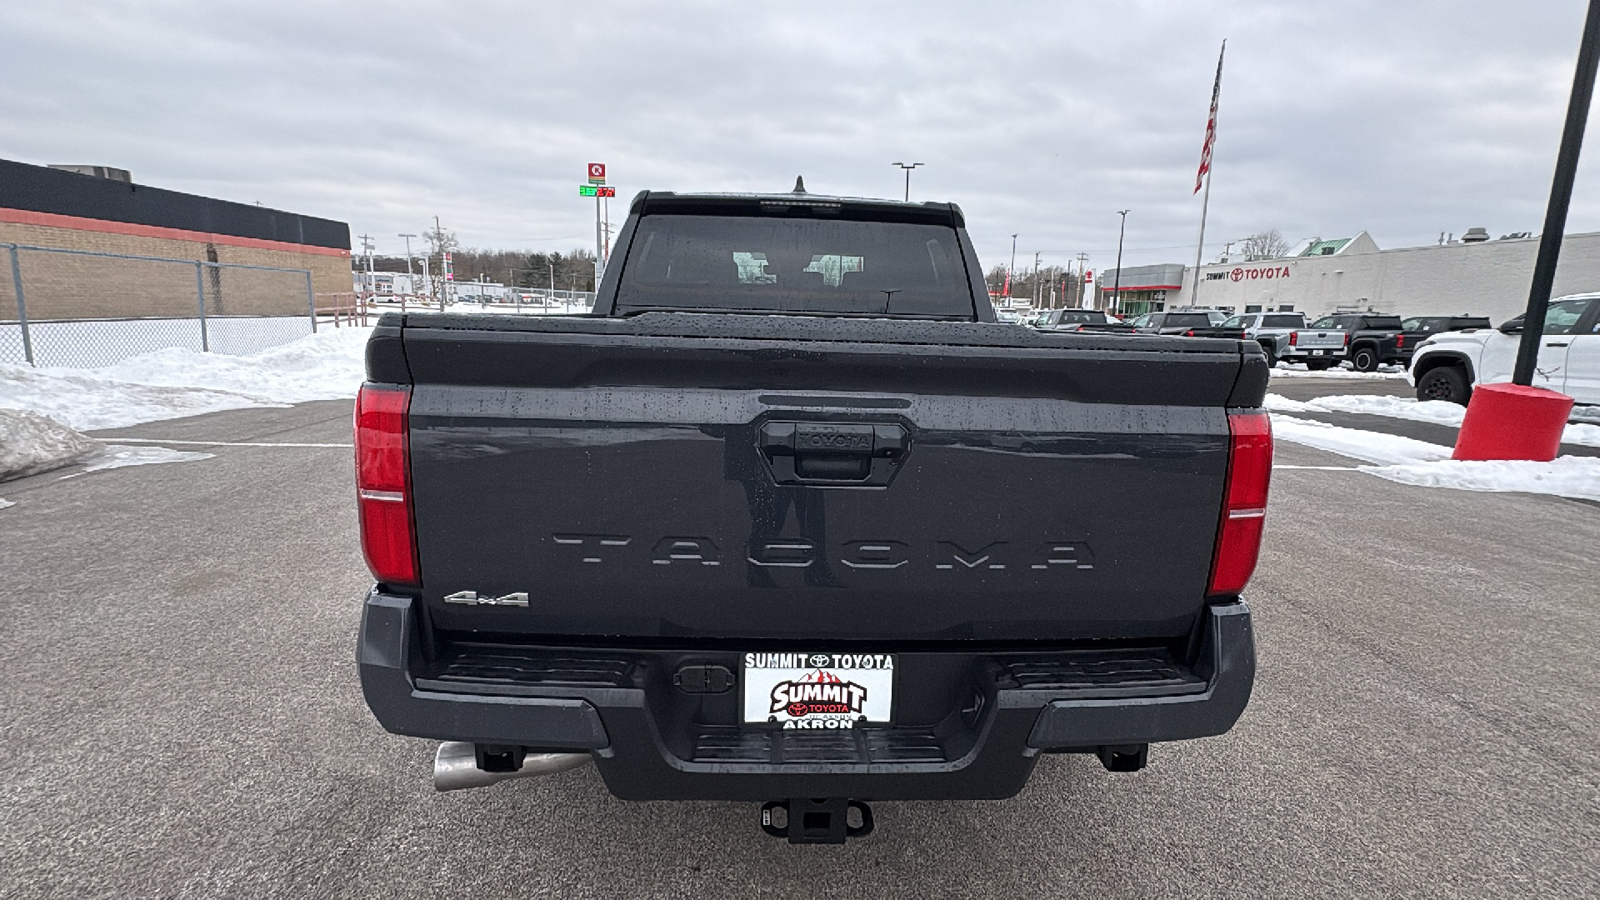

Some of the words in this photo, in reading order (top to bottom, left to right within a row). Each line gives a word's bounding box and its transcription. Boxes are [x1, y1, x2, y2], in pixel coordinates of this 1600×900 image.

[1206, 271, 1230, 281] SUMMIT
[1245, 266, 1290, 280] TOYOTA
[799, 433, 869, 448] TOYOTA
[553, 533, 1095, 569] TACOMA
[744, 652, 808, 669] SUMMIT
[831, 654, 894, 670] TOYOTA
[771, 682, 866, 713] SUMMIT
[808, 704, 849, 713] TOYOTA
[783, 719, 853, 730] AKRON
